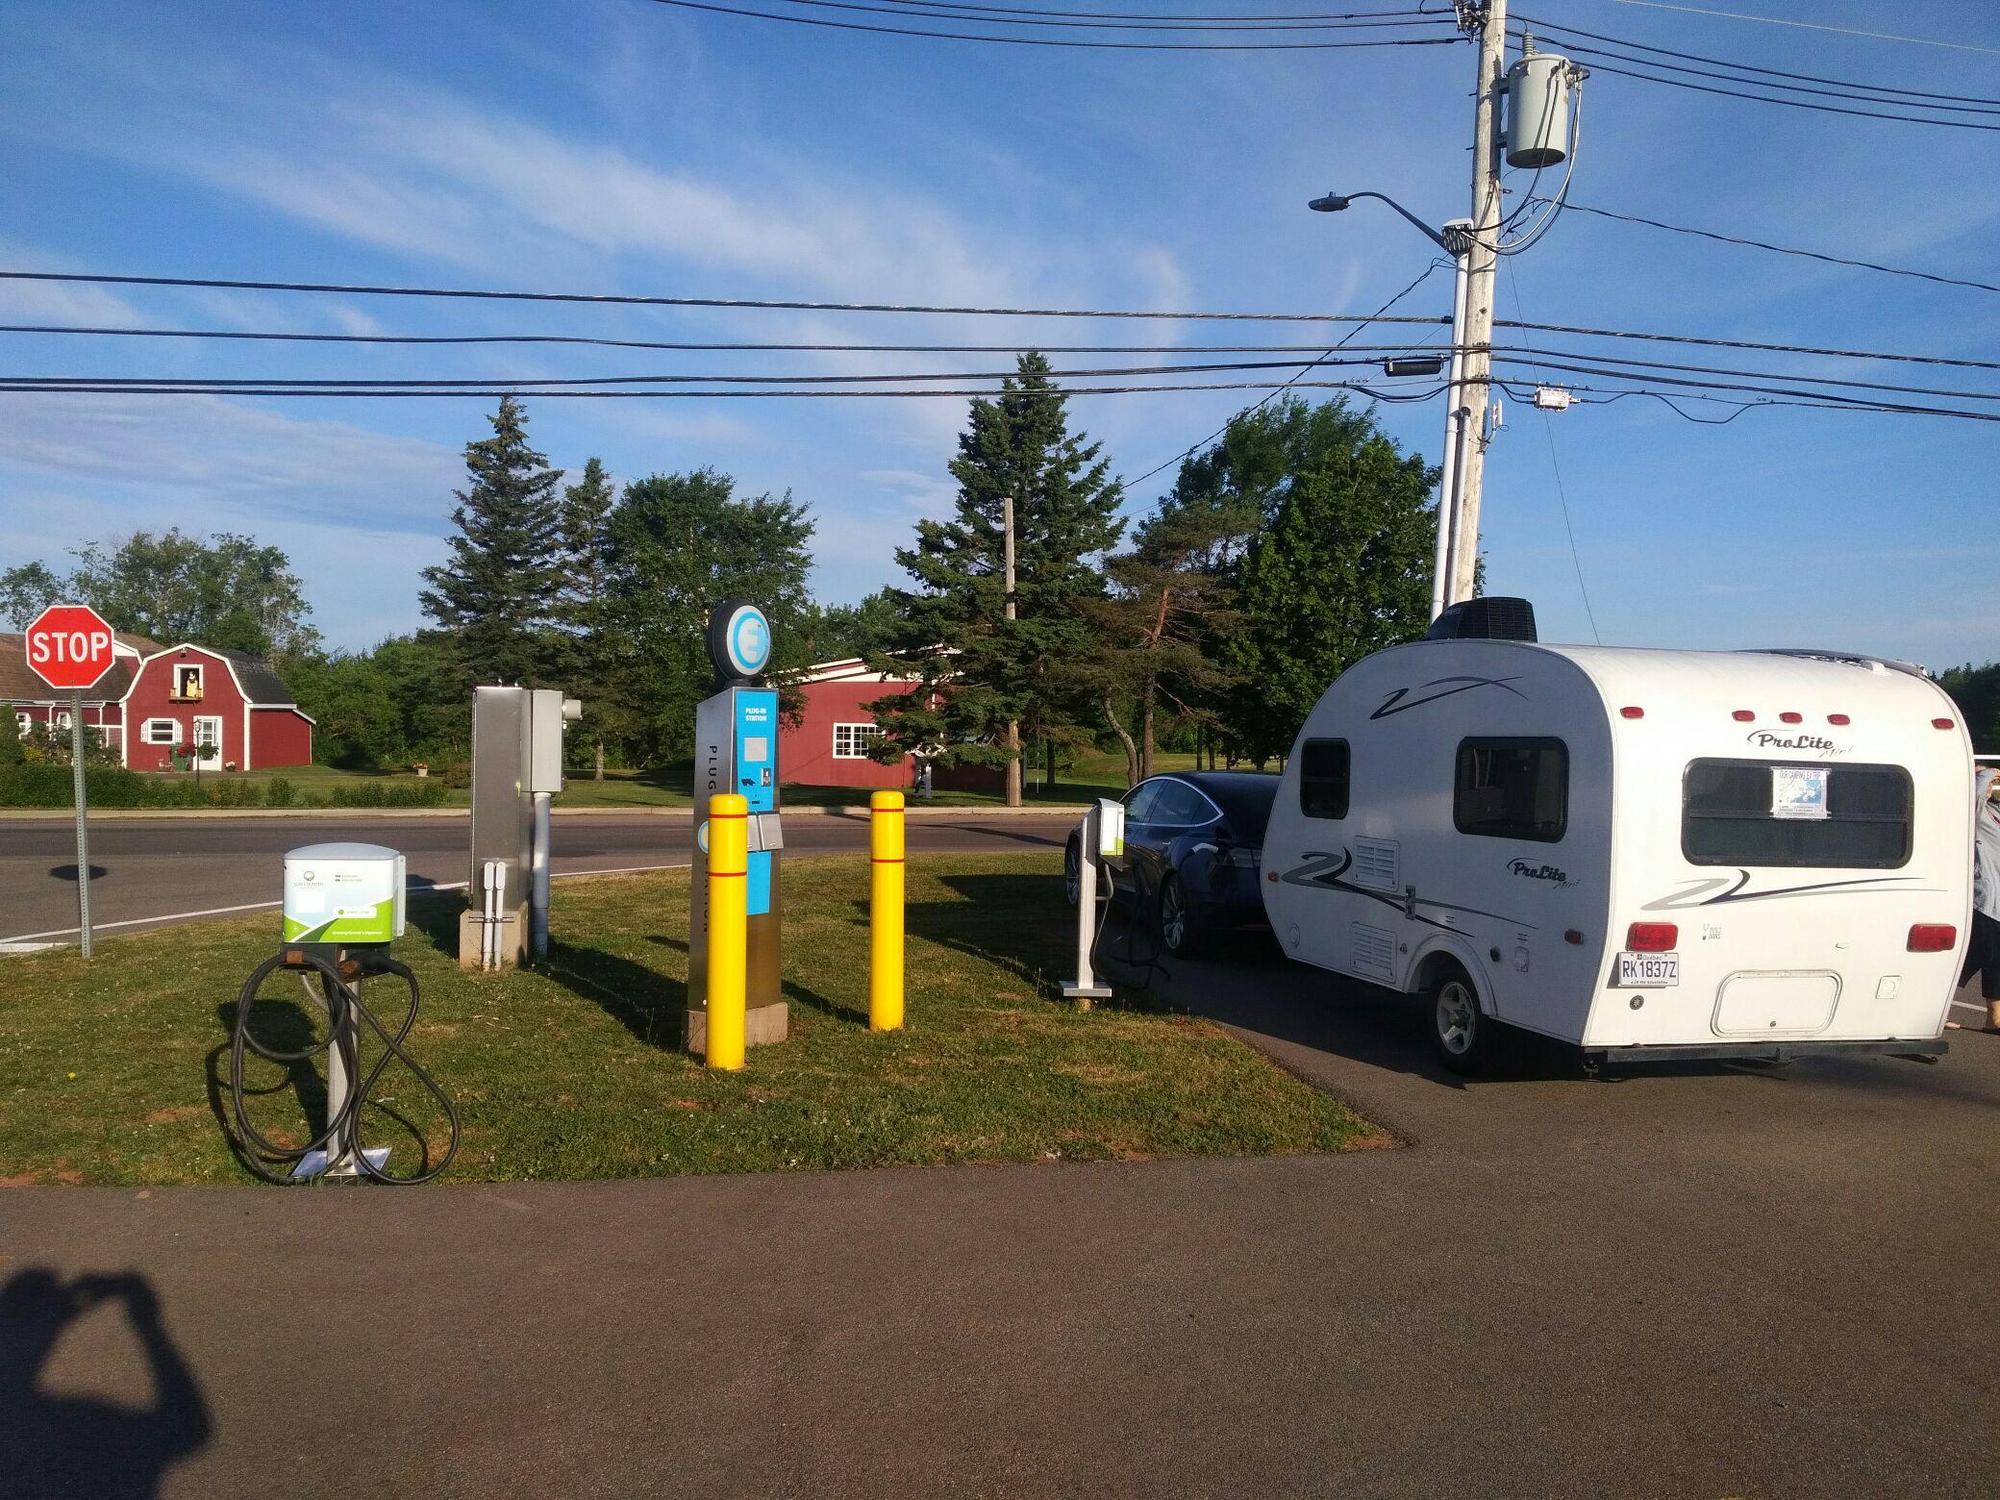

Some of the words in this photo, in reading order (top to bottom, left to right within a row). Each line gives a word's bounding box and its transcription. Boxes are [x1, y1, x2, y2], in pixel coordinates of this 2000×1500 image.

[32, 631, 109, 663] STOP
[1757, 733, 1834, 750] ProLite
[1513, 861, 1567, 881] ProLite
[1622, 960, 1677, 978] RK1837Z
